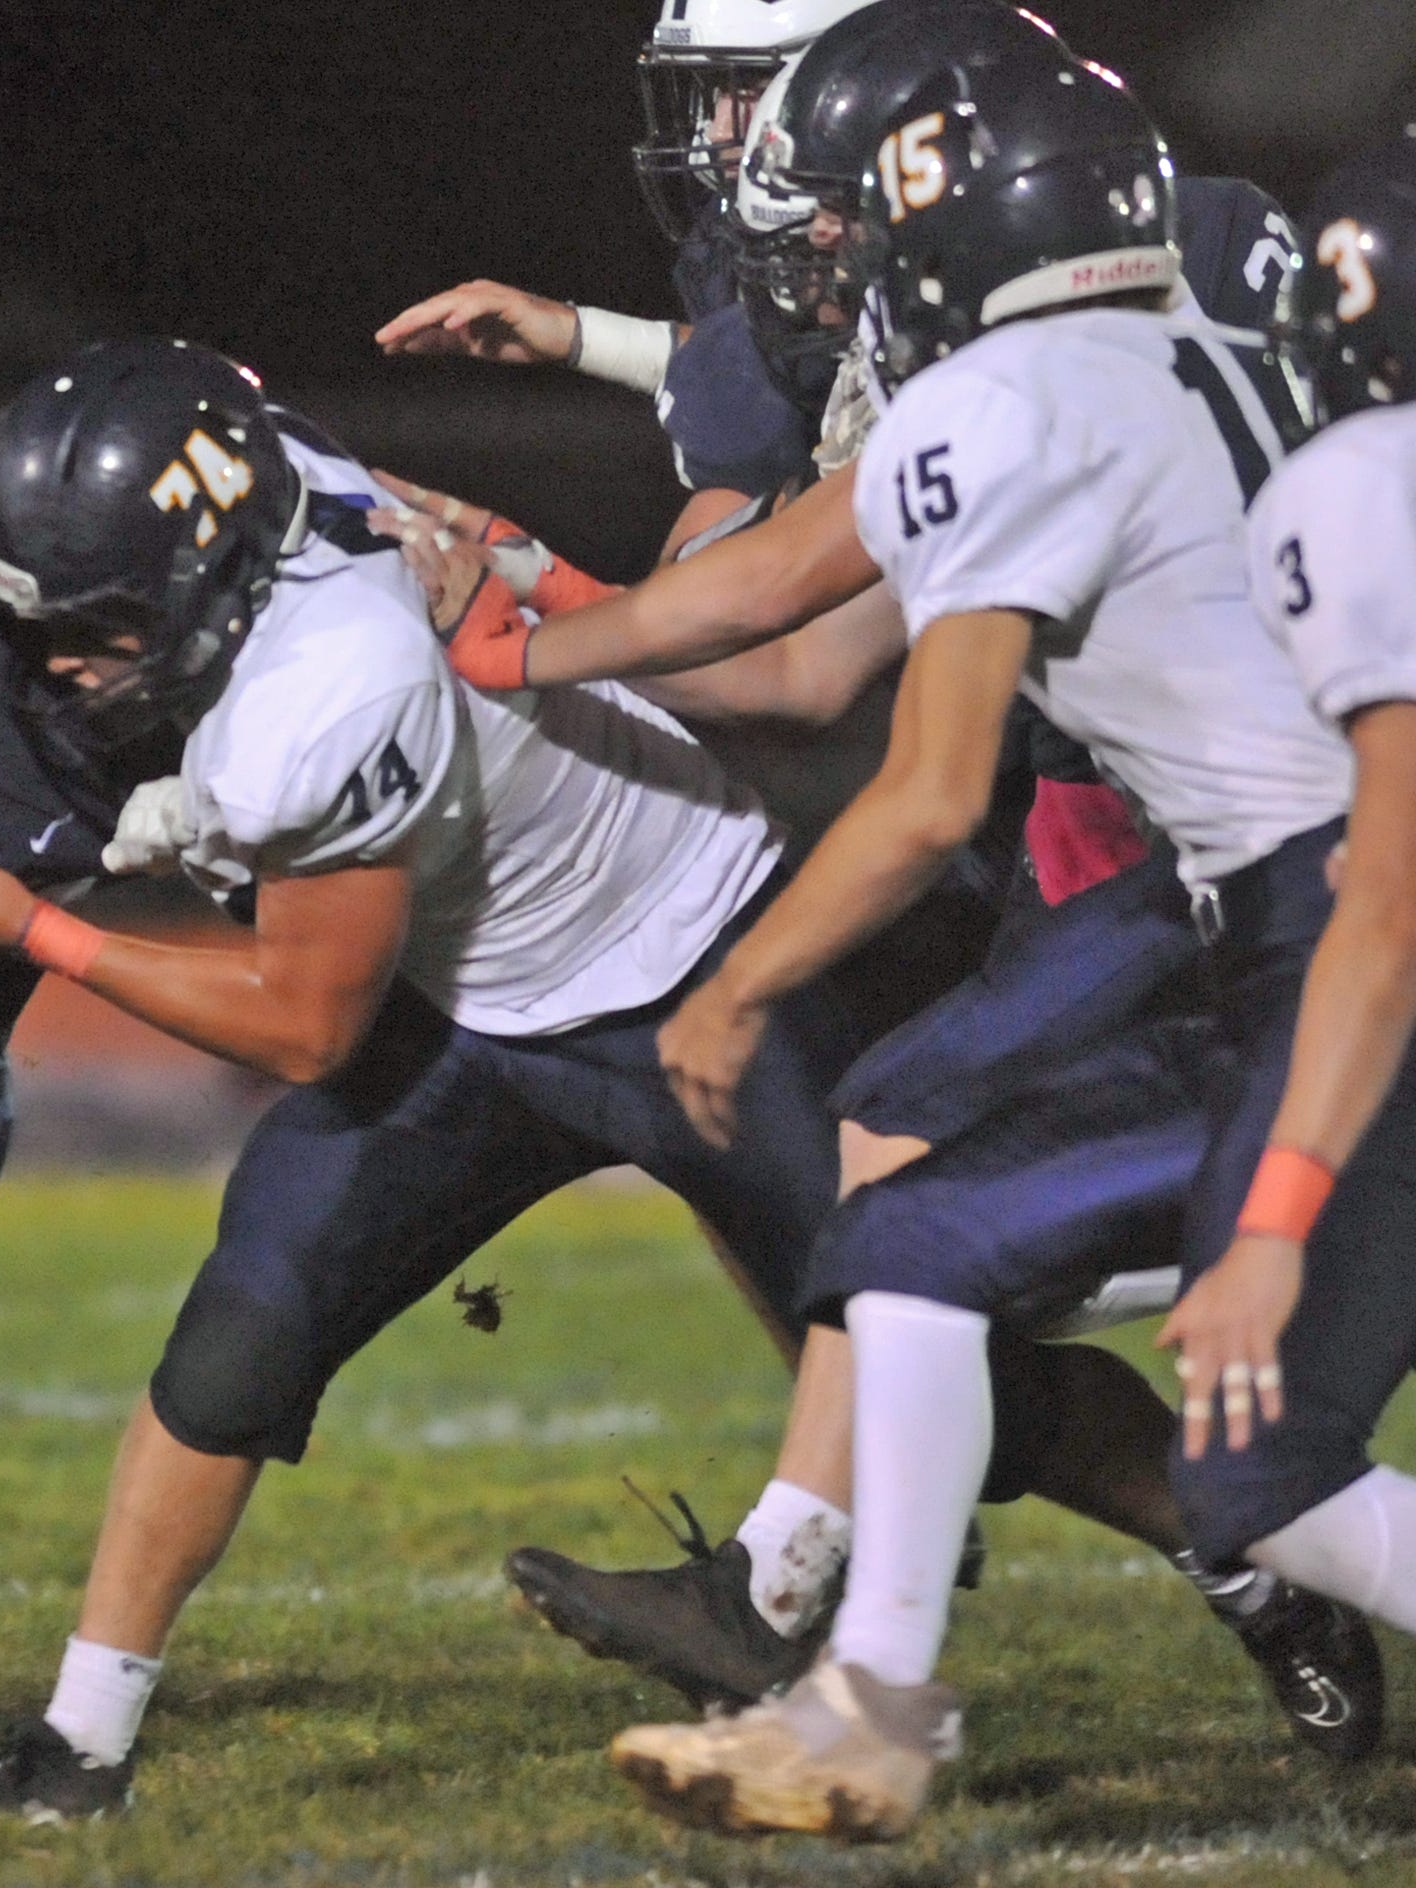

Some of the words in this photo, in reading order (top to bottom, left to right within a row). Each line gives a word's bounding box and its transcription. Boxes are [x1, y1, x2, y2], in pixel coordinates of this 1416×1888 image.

[876, 111, 946, 224] 15
[1316, 216, 1376, 324] 3
[149, 428, 256, 548] 74
[896, 443, 959, 539] 15
[1277, 537, 1312, 616] 3
